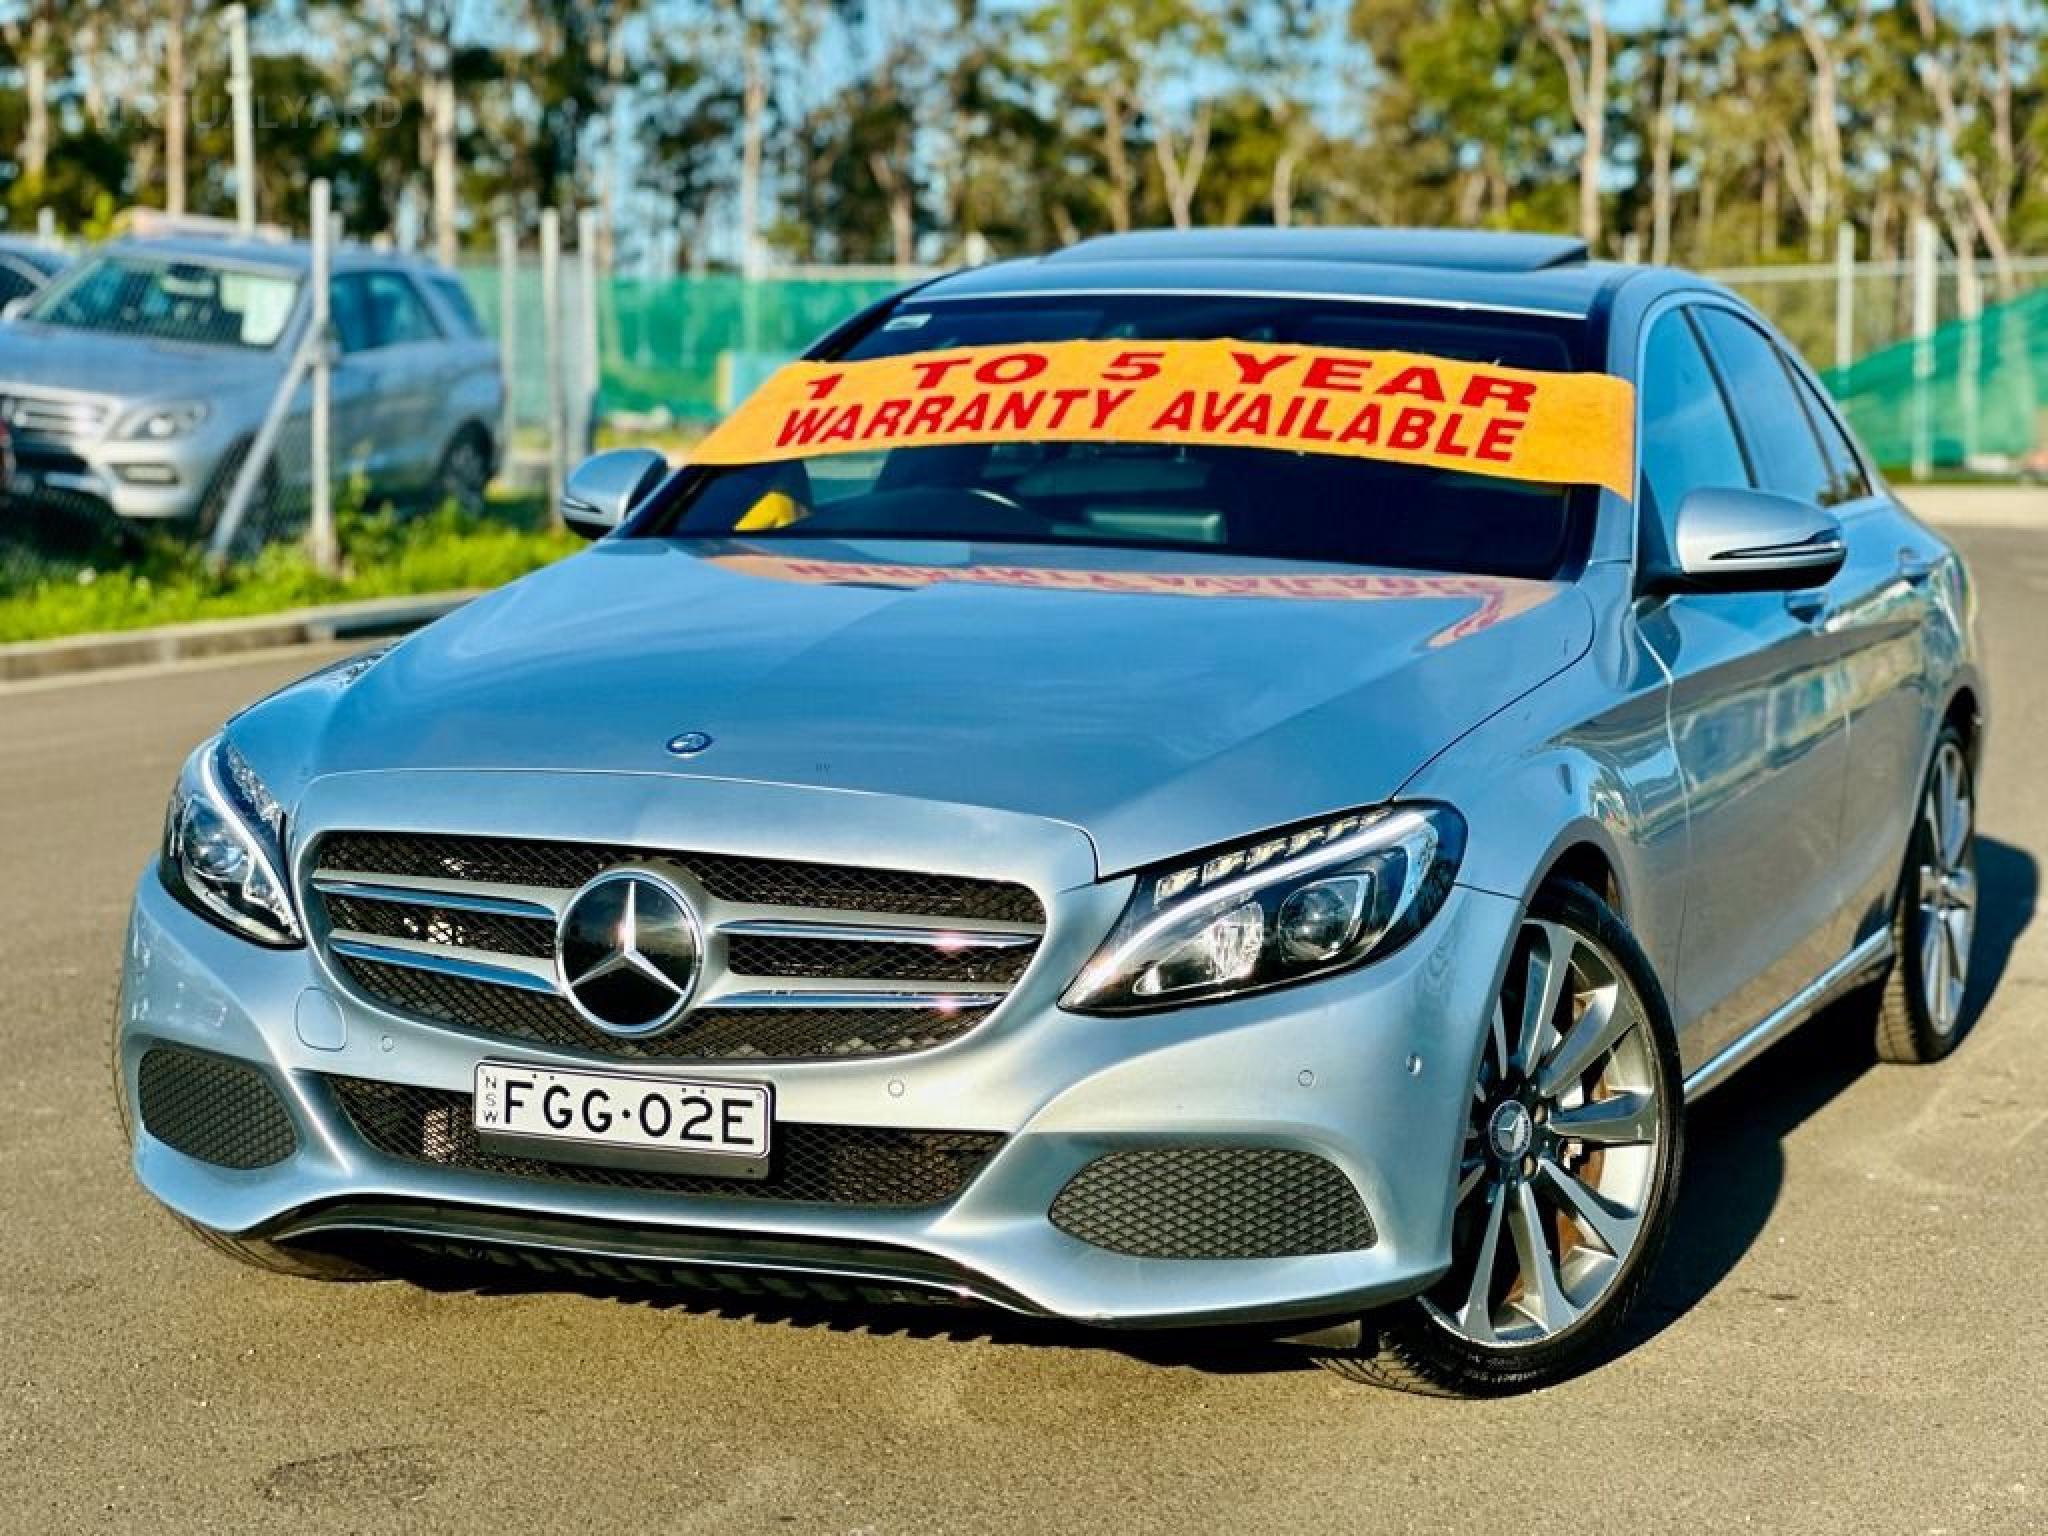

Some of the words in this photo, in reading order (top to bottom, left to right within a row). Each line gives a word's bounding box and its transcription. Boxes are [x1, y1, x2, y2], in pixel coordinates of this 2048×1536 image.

[807, 373, 844, 402] 1
[912, 353, 1050, 391] TO
[1101, 351, 1166, 382] 5
[1230, 351, 1538, 413] YEAR
[774, 389, 1136, 447] WARRANTY
[1150, 390, 1526, 462] AVAILABLE
[483, 1075, 499, 1123] NSW
